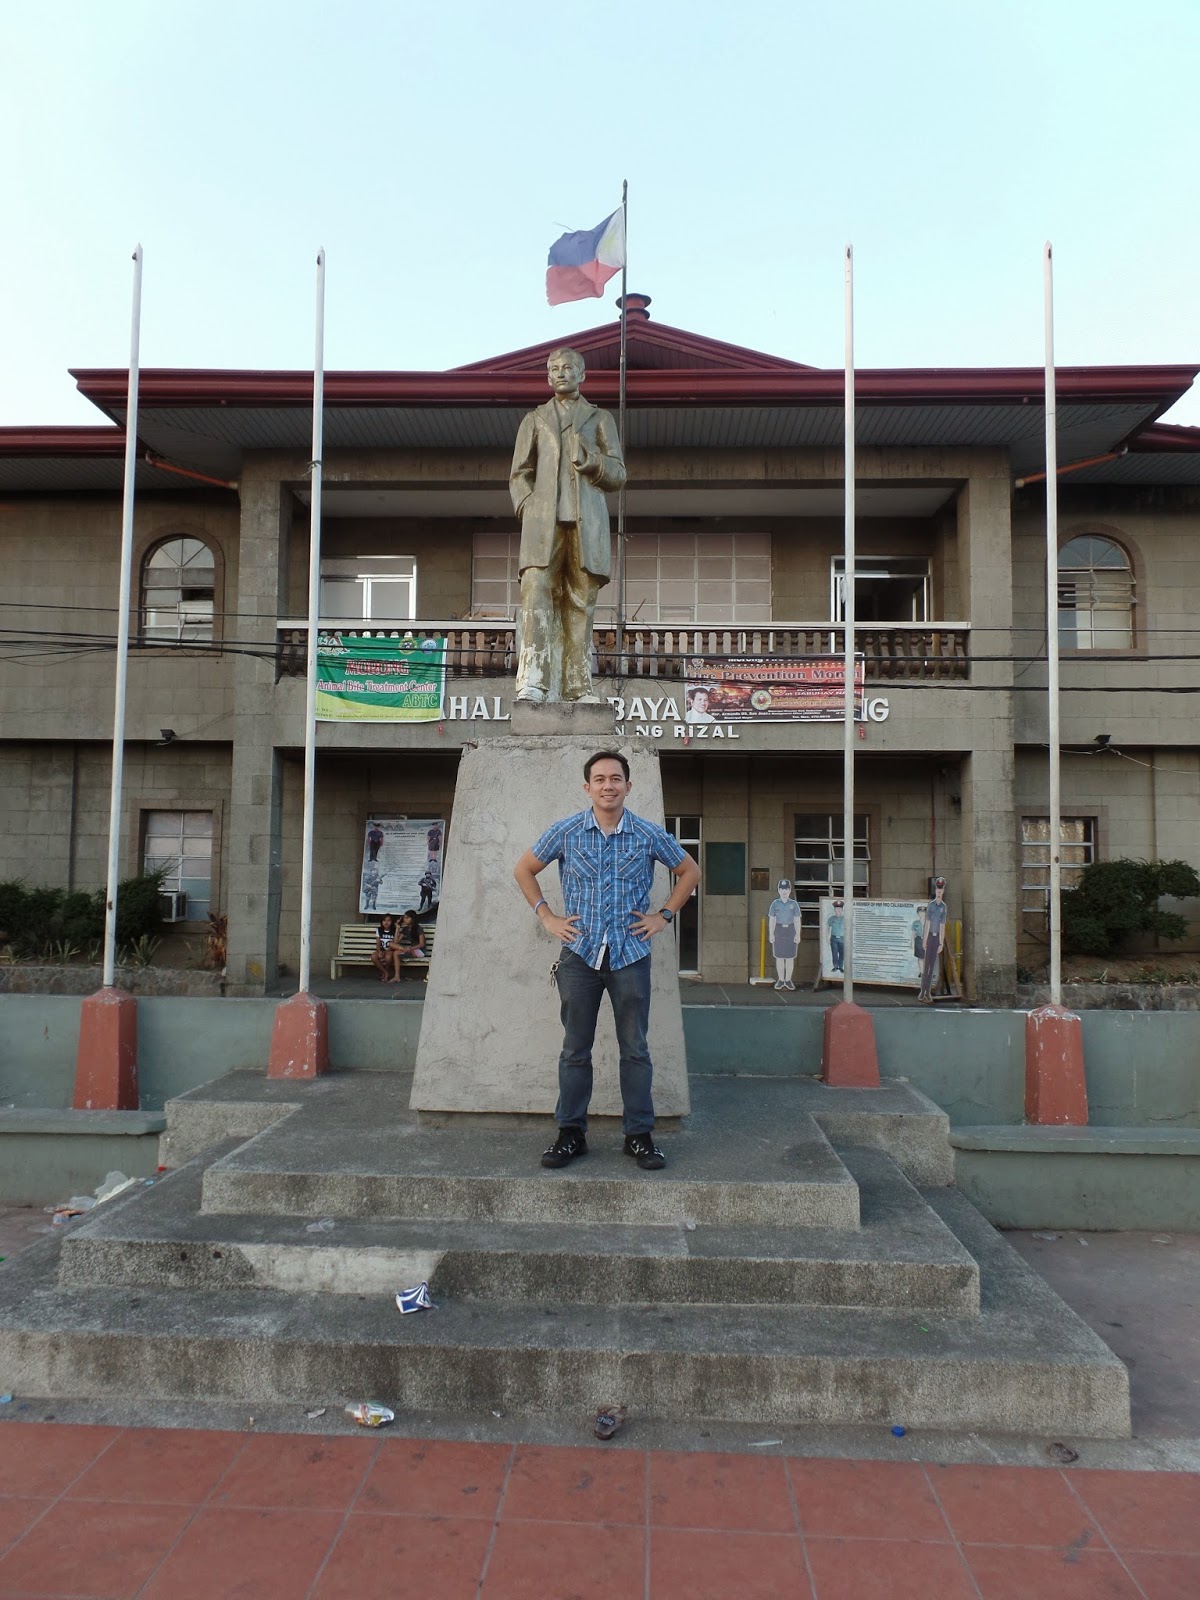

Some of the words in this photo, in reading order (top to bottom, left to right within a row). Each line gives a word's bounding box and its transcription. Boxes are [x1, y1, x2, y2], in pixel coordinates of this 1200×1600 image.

[345, 659, 409, 675] MORONG
[722, 671, 806, 680] Prevention
[812, 670, 860, 679] Monh
[317, 679, 345, 691] Animal
[347, 680, 365, 692] Bite
[366, 680, 408, 693] Treatment
[409, 680, 437, 692] Center
[402, 694, 437, 708] ABTC
[442, 696, 512, 720] HAL
[636, 725, 663, 738] NG
[674, 725, 740, 738] RIZAL
